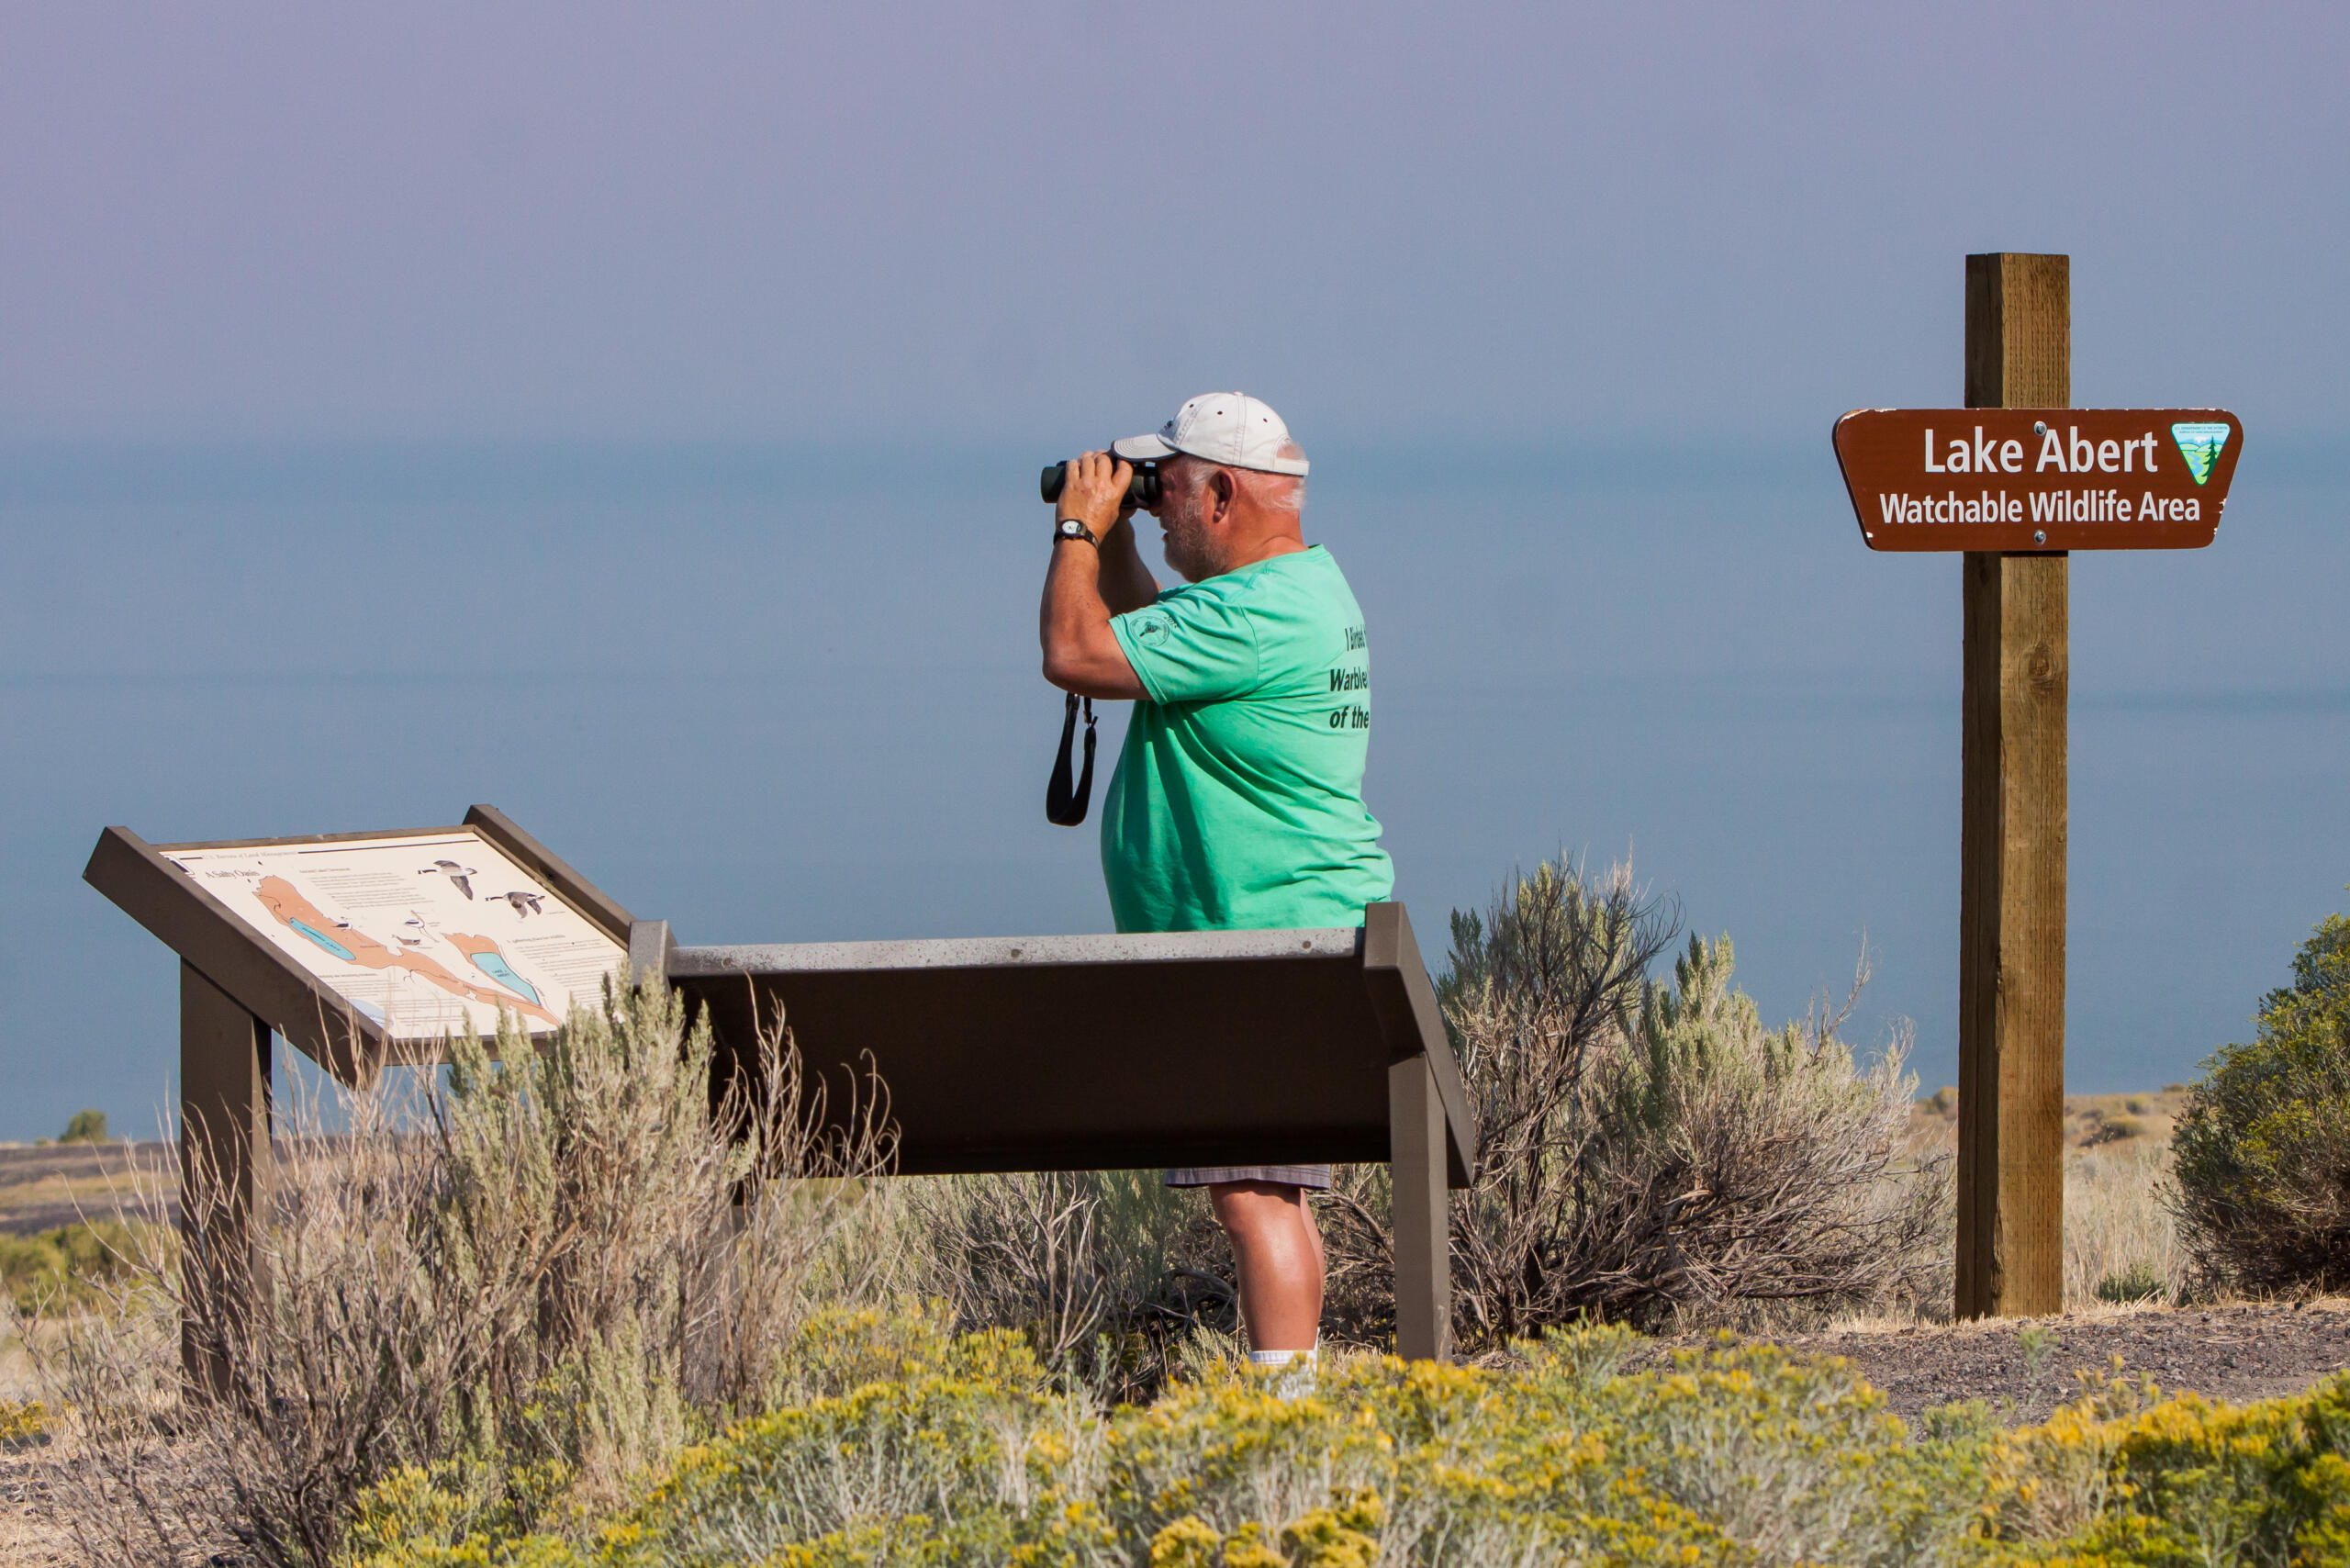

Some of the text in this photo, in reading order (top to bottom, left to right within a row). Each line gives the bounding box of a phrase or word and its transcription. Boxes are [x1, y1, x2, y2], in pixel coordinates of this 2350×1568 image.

[1925, 426, 2158, 473] Lake Abert
[1880, 489, 2200, 524] Watchable Wildlife Area
[1330, 666, 1369, 692] Warble
[1329, 706, 1370, 729] of the
